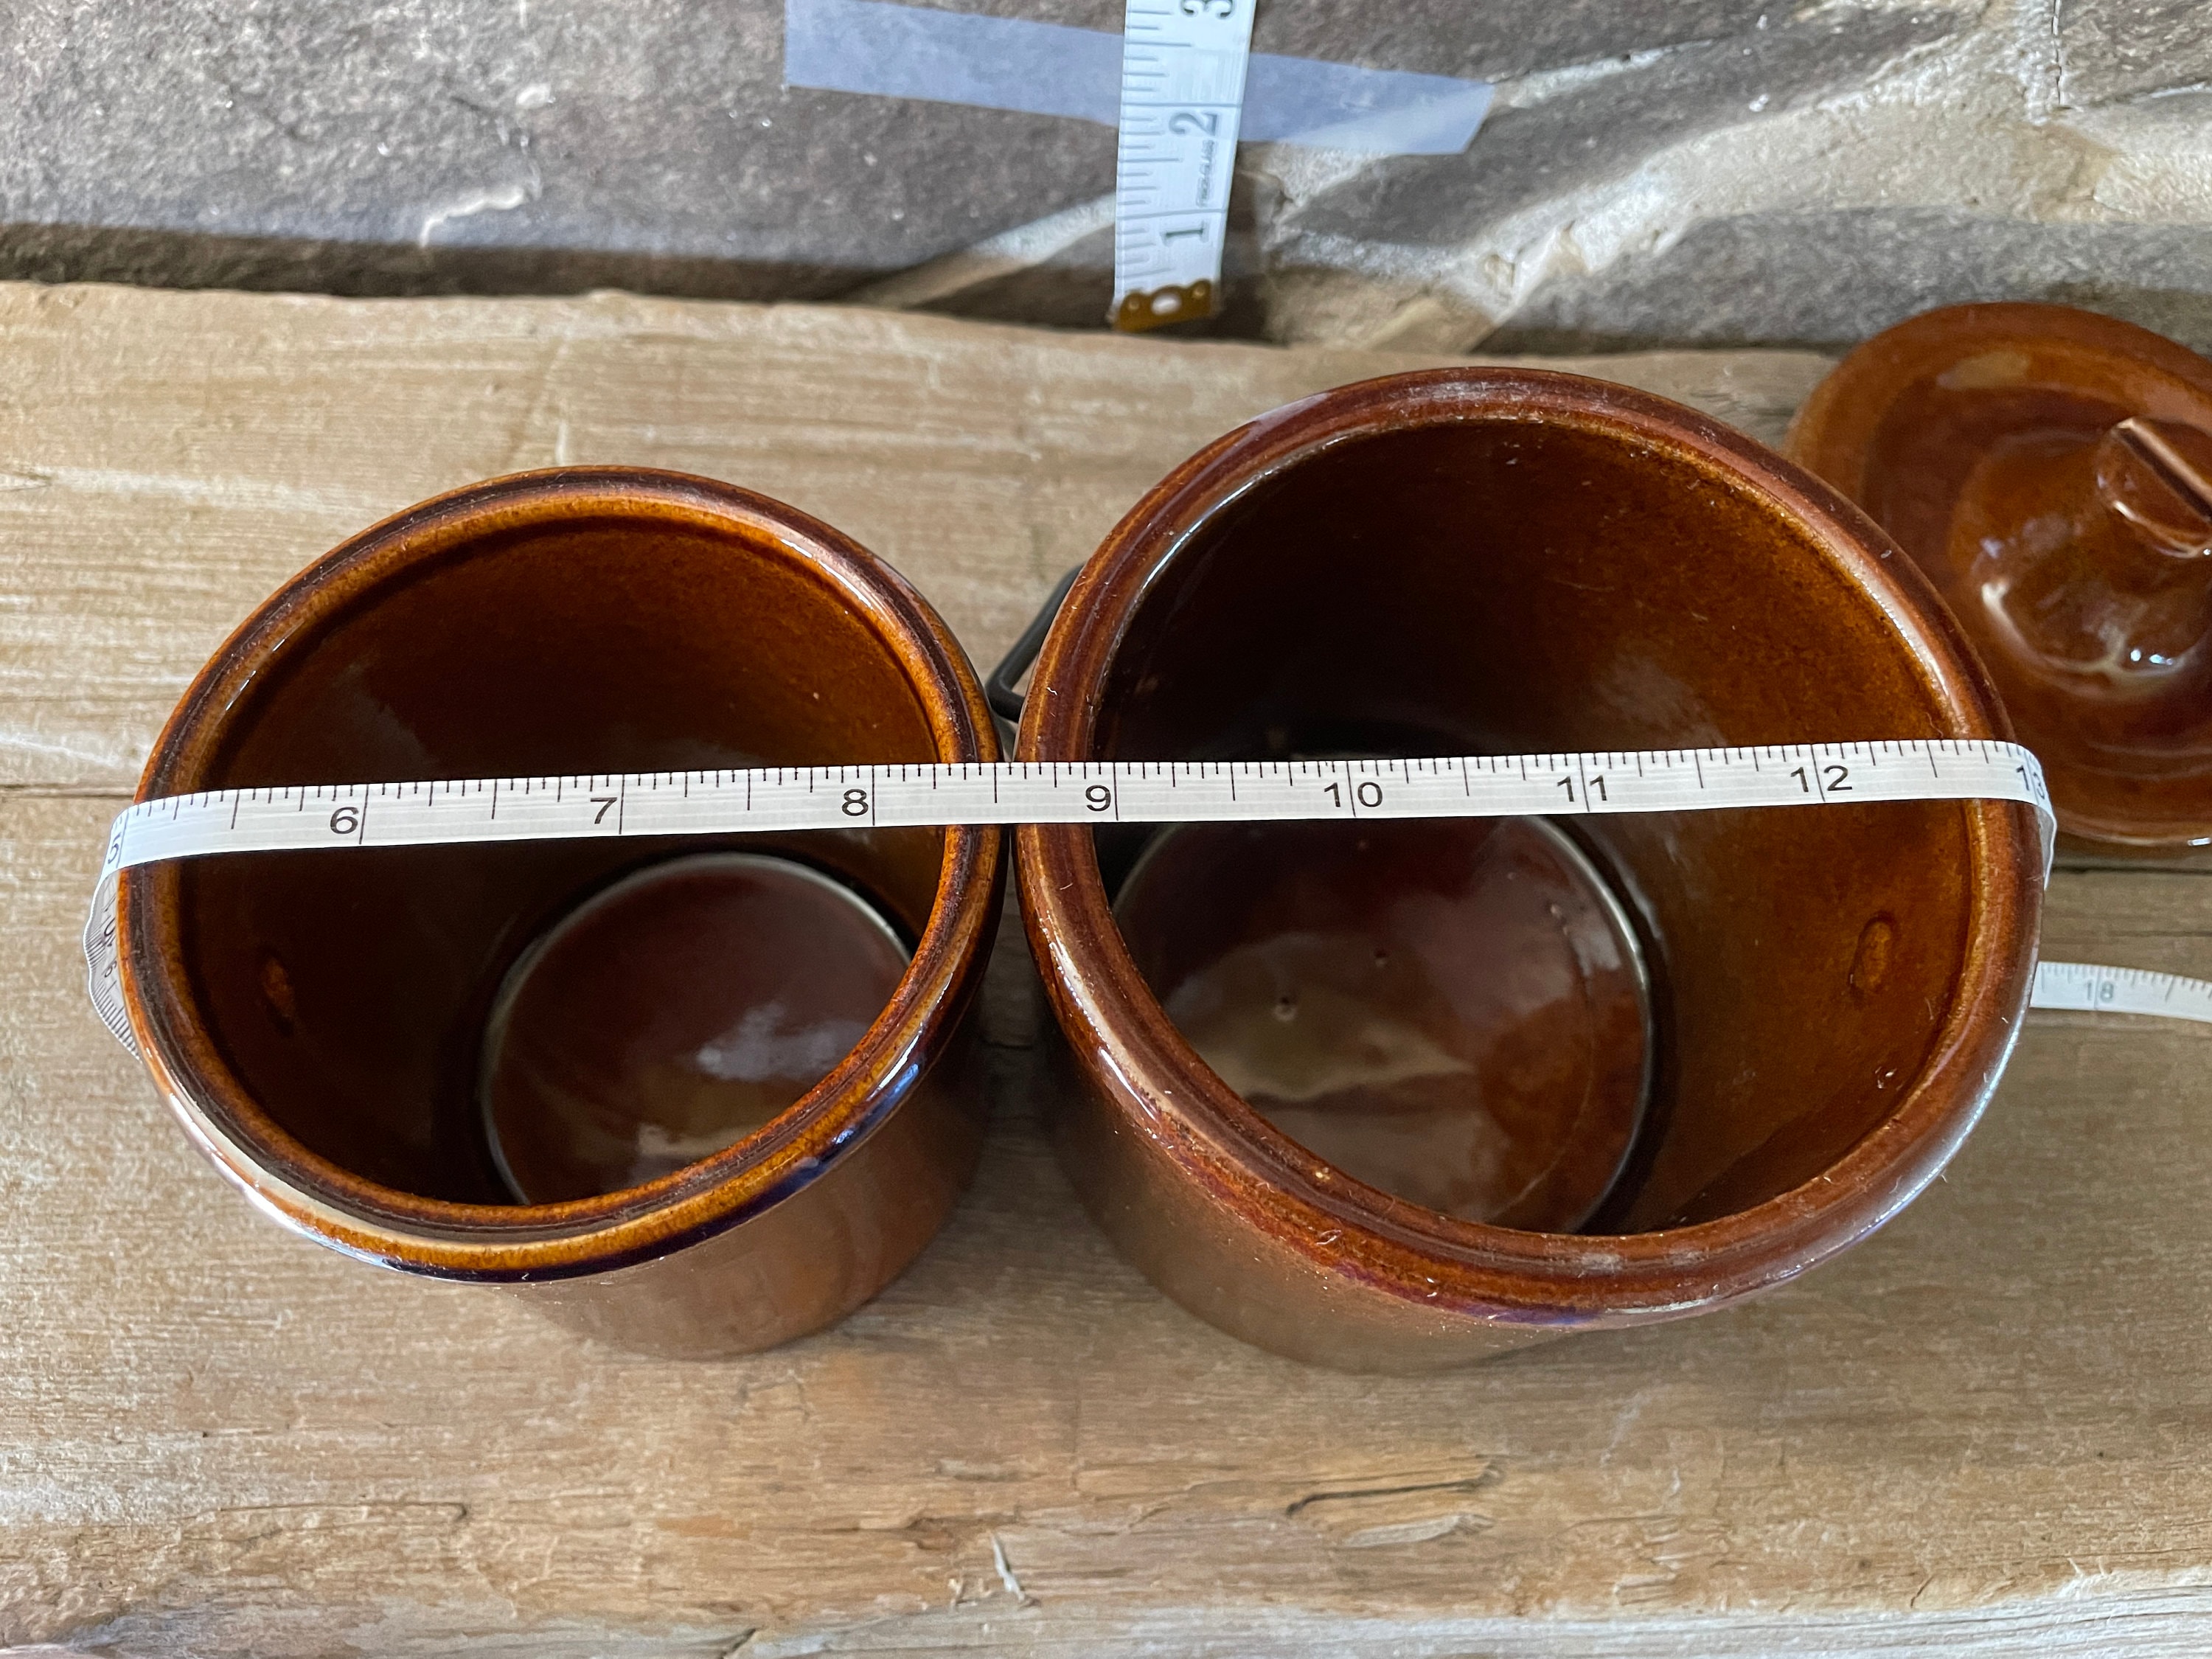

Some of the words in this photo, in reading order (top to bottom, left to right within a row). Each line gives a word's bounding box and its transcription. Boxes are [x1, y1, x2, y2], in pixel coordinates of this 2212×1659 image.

[1169, 113, 1218, 136] 2
[1161, 222, 1209, 245] 1
[107, 832, 122, 865] 5
[330, 807, 359, 835] 6
[591, 797, 617, 824] 7
[842, 788, 869, 816] 8
[1085, 785, 1111, 812] 9
[1324, 782, 1384, 808] 10
[1557, 775, 1611, 802] 11
[1790, 765, 1853, 793] 12
[2016, 765, 2045, 799] 13
[2085, 980, 2115, 1003] 18
